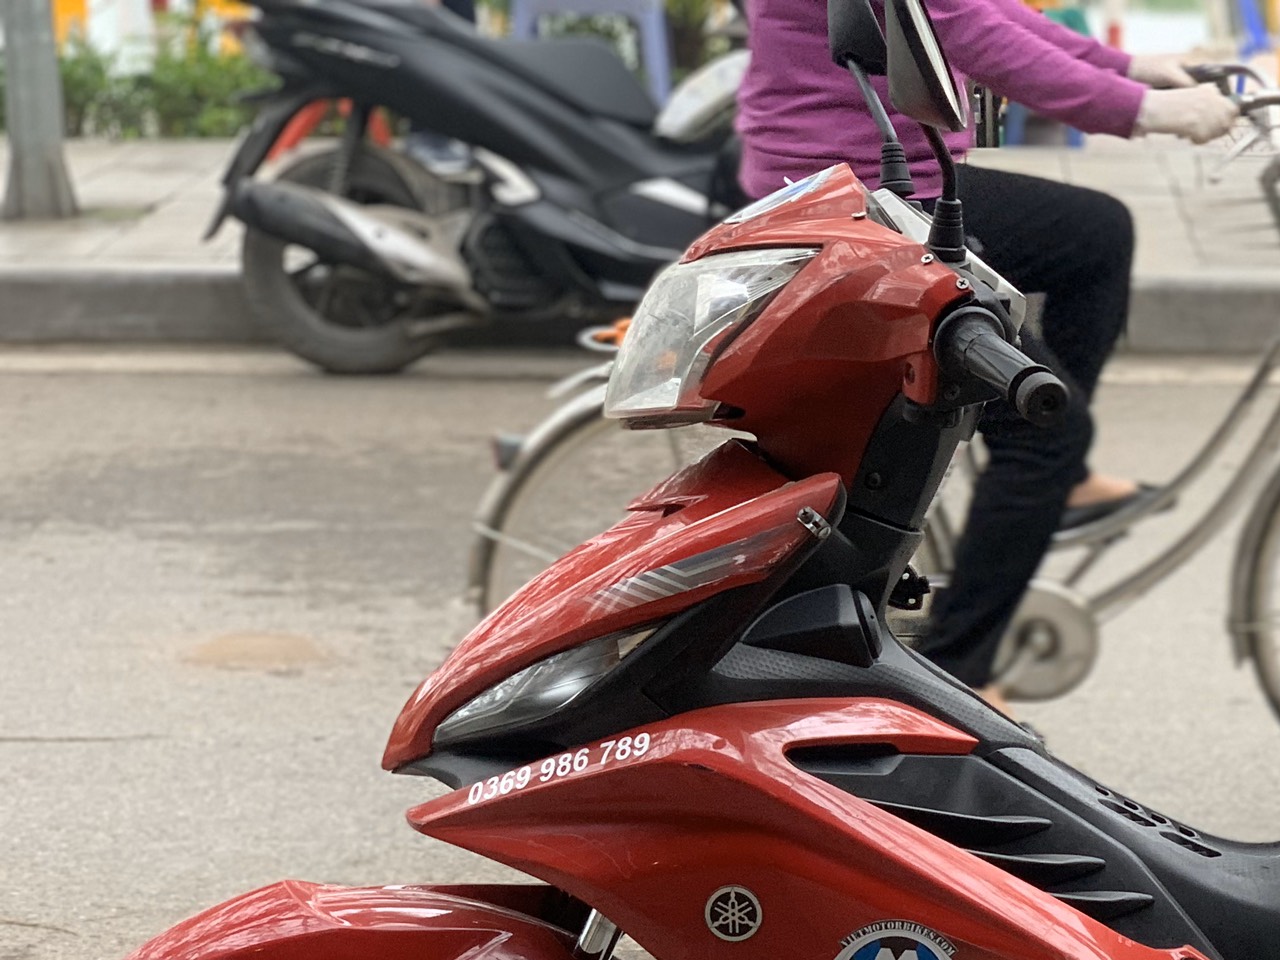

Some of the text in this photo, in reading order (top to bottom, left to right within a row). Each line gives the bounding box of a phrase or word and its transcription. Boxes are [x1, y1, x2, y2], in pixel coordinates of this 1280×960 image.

[468, 733, 650, 805] 0369 986 789
[841, 921, 956, 956] VIETMOTORBIKES.COM
